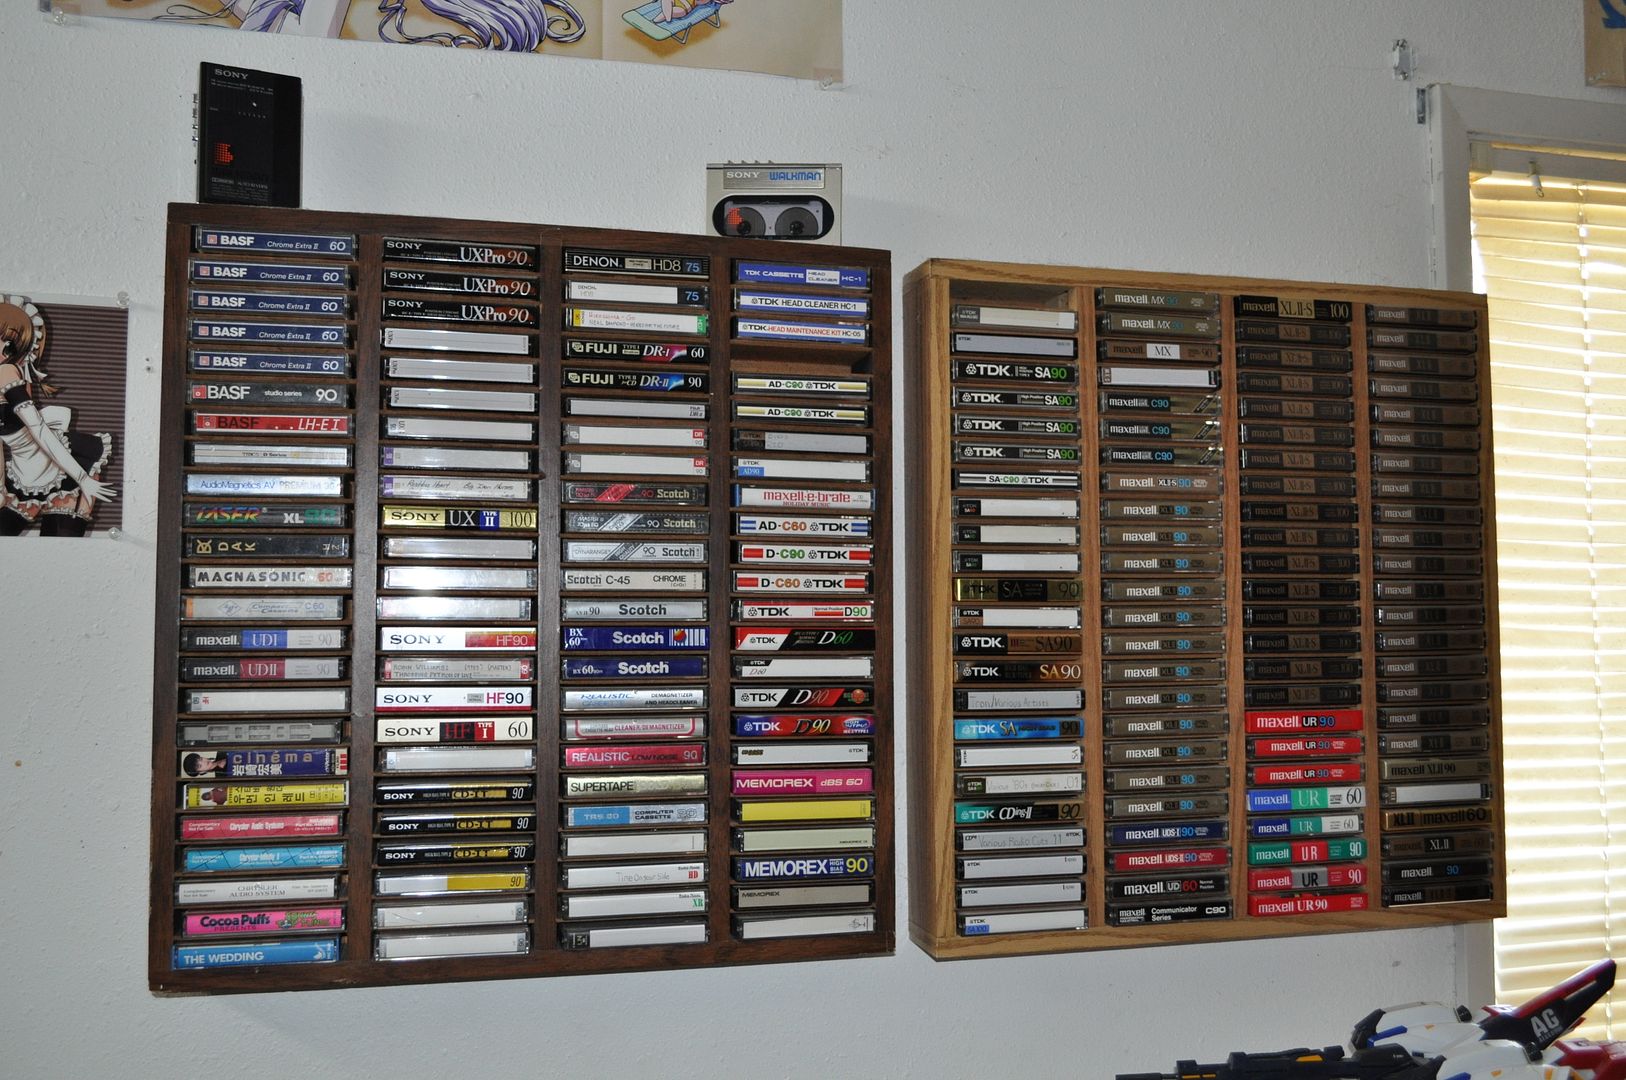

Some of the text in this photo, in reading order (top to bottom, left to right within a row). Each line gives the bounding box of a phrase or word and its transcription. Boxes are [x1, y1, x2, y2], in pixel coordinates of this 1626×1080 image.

[215, 69, 248, 79] SONY
[769, 172, 821, 180] WALKMAN
[221, 236, 254, 246] BASF
[330, 242, 345, 251] 60
[387, 242, 528, 265] SONY 90
[573, 255, 618, 267] DENON
[653, 260, 681, 271] HD8
[686, 263, 699, 272] 75
[213, 267, 339, 281] BASF 60
[390, 272, 531, 295] SONY 90
[212, 297, 246, 306] BASF
[782, 299, 803, 307] HEAD
[805, 300, 839, 309] CLEANER
[1115, 295, 1165, 305] maxell MX
[388, 300, 529, 323] SONY 90
[1243, 302, 1349, 318] maxell 100
[1157, 321, 1170, 329] MX
[787, 327, 830, 335] MAINTENANCE
[585, 343, 617, 354] FUJI
[1155, 346, 1171, 356] MX
[976, 364, 1067, 379] TDK SA90
[582, 373, 702, 388] FUJI 90
[207, 386, 250, 399] BASF
[316, 389, 337, 401] 90
[971, 393, 1072, 405] TDK SA90
[1151, 400, 1169, 408] C90
[972, 421, 1073, 433] TDK SA90
[1152, 426, 1169, 434] C90
[973, 448, 1074, 459] TDK SA90
[1154, 452, 1172, 460] C90
[201, 481, 261, 490] AudioMagnetics
[657, 489, 689, 498] Scotch
[450, 511, 475, 526] UX
[510, 512, 532, 527] 100
[663, 519, 696, 528] Scotch
[662, 547, 695, 557] Scotch
[198, 572, 306, 582] MAGNASONIC
[606, 576, 631, 584] C-45
[1002, 582, 1080, 596] SA 90
[619, 604, 667, 616] Scotch
[844, 607, 868, 616] D90
[390, 635, 445, 644] SONY
[569, 628, 664, 644] BX Scotch
[818, 631, 853, 644] D60
[971, 636, 1072, 649] TDK SA90
[618, 662, 669, 674] Scotch
[971, 667, 999, 676] TDK
[1040, 665, 1081, 679] SA90
[384, 695, 432, 703] SONY
[791, 690, 829, 705] D90
[1257, 716, 1317, 728] maxell UR
[385, 722, 528, 739] SONY HF 60
[971, 725, 995, 734] TDK
[1000, 721, 1017, 736] SA
[572, 752, 630, 762] REALISTIC
[571, 781, 634, 792] SUPERTAPE
[736, 779, 843, 788] MEMOREX dBS
[512, 788, 524, 799] 90
[1298, 788, 1362, 806] UR 60
[968, 810, 995, 819] TDK
[517, 818, 529, 829] 90
[1430, 839, 1449, 850] XLII
[514, 847, 526, 858] 90
[1256, 842, 1361, 860] maxell 90
[745, 858, 868, 877] MEMOREX 90
[1401, 867, 1432, 878] maxell
[510, 876, 521, 887] 90
[1302, 869, 1361, 886] UR 90
[1124, 881, 1197, 895] maxell UD 60
[1394, 892, 1422, 901] maxell
[1151, 906, 1197, 914] Communicator
[1259, 902, 1294, 913] maxell
[201, 916, 239, 926] Cocoa
[241, 914, 270, 925] Puffs
[184, 952, 264, 964] THE WEDDING
[1530, 1009, 1560, 1038] AG
